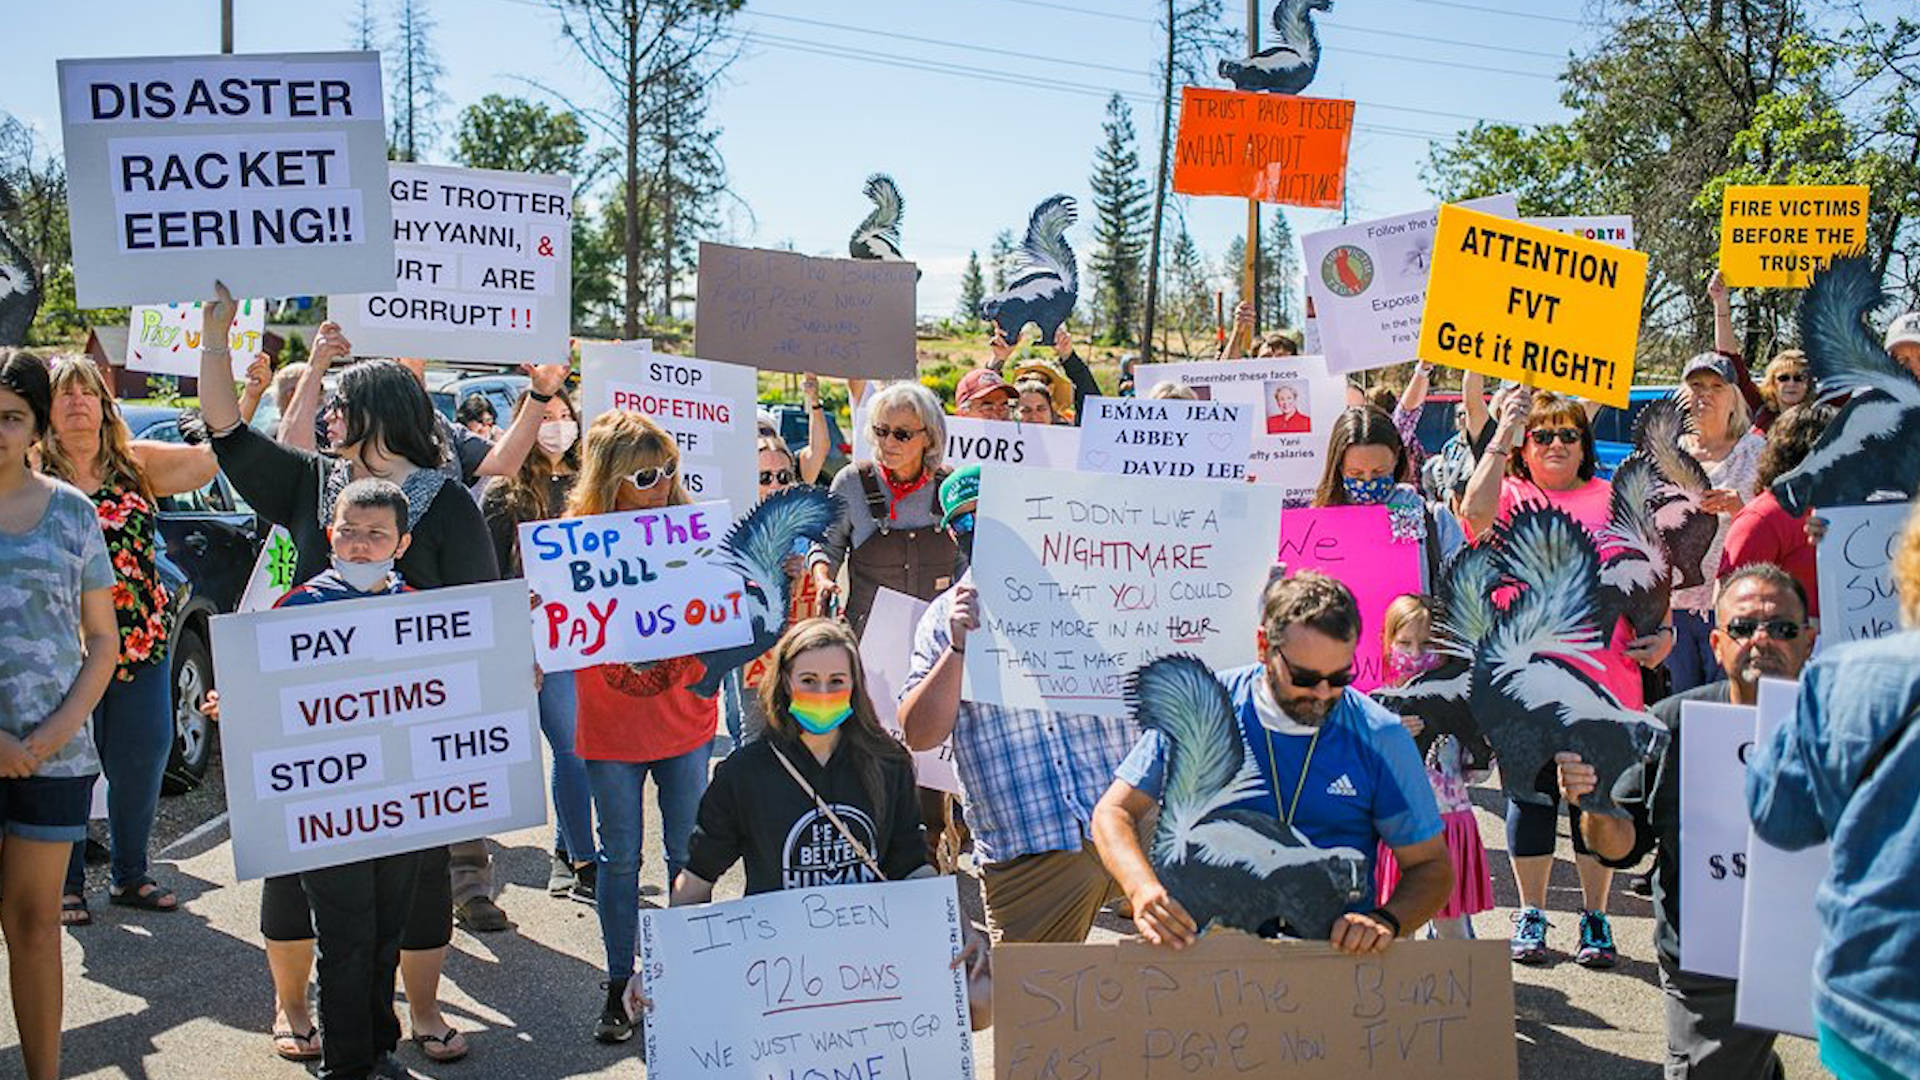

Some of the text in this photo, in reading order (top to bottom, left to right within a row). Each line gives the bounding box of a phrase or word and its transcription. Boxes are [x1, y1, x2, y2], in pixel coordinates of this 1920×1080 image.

[90, 79, 352, 119] DISASTER
[1193, 98, 1355, 130] TRUST PAYS ITSELF
[1178, 134, 1305, 170] WHAT ABOUT
[122, 149, 335, 192] RACKET
[390, 180, 572, 221] GE TROTTER,
[1730, 200, 1860, 216] FIRE VICTIMS
[125, 206, 352, 248] EERING!!
[394, 219, 554, 257] HYYANNI, &
[1367, 223, 1406, 239] Follow
[1408, 219, 1427, 232] the
[1733, 228, 1854, 243] BEFORE THE
[1460, 226, 1618, 289] ATTENTION
[481, 267, 536, 290] ARE
[1372, 295, 1420, 312] Expose
[1507, 286, 1561, 324] FVT
[231, 330, 259, 352] UT
[1438, 321, 1616, 390] Get it RIGHT!
[650, 363, 702, 386] STOP
[1182, 370, 1298, 383] Remember these faces
[614, 392, 729, 424] PROFETING
[1101, 403, 1239, 422] EMMA JEAN
[948, 436, 1025, 463] IVORS
[1115, 430, 1189, 447] ABBEY
[1273, 449, 1314, 459] salaries
[1122, 460, 1246, 480] DAVID LEE
[1025, 496, 1219, 533] I DIDN'T LIVE A
[1041, 531, 1212, 577] NIGHTMARE
[1005, 577, 1232, 609] SO THAT YOU COULD
[290, 611, 471, 662] PAY FIRE
[635, 604, 676, 637] US
[987, 615, 1220, 639] MAKE MORE IN AN HOUR
[985, 649, 1048, 669] THAN
[1054, 650, 1075, 669] I
[1084, 652, 1129, 668] MAKE
[1023, 674, 1079, 694] TWO
[299, 679, 447, 727] VICTIMS
[270, 726, 510, 792] STOP THIS
[297, 782, 489, 844] INJUSTICE
[801, 845, 856, 865] BETTE
[746, 954, 900, 1006] 926 DAYS
[1018, 965, 1179, 1031] STOP
[1354, 954, 1472, 1018] BURN
[750, 1033, 801, 1062] JUST
[810, 1027, 868, 1052] WANT
[874, 1021, 908, 1042] TO
[1360, 1015, 1467, 1070] FVT
